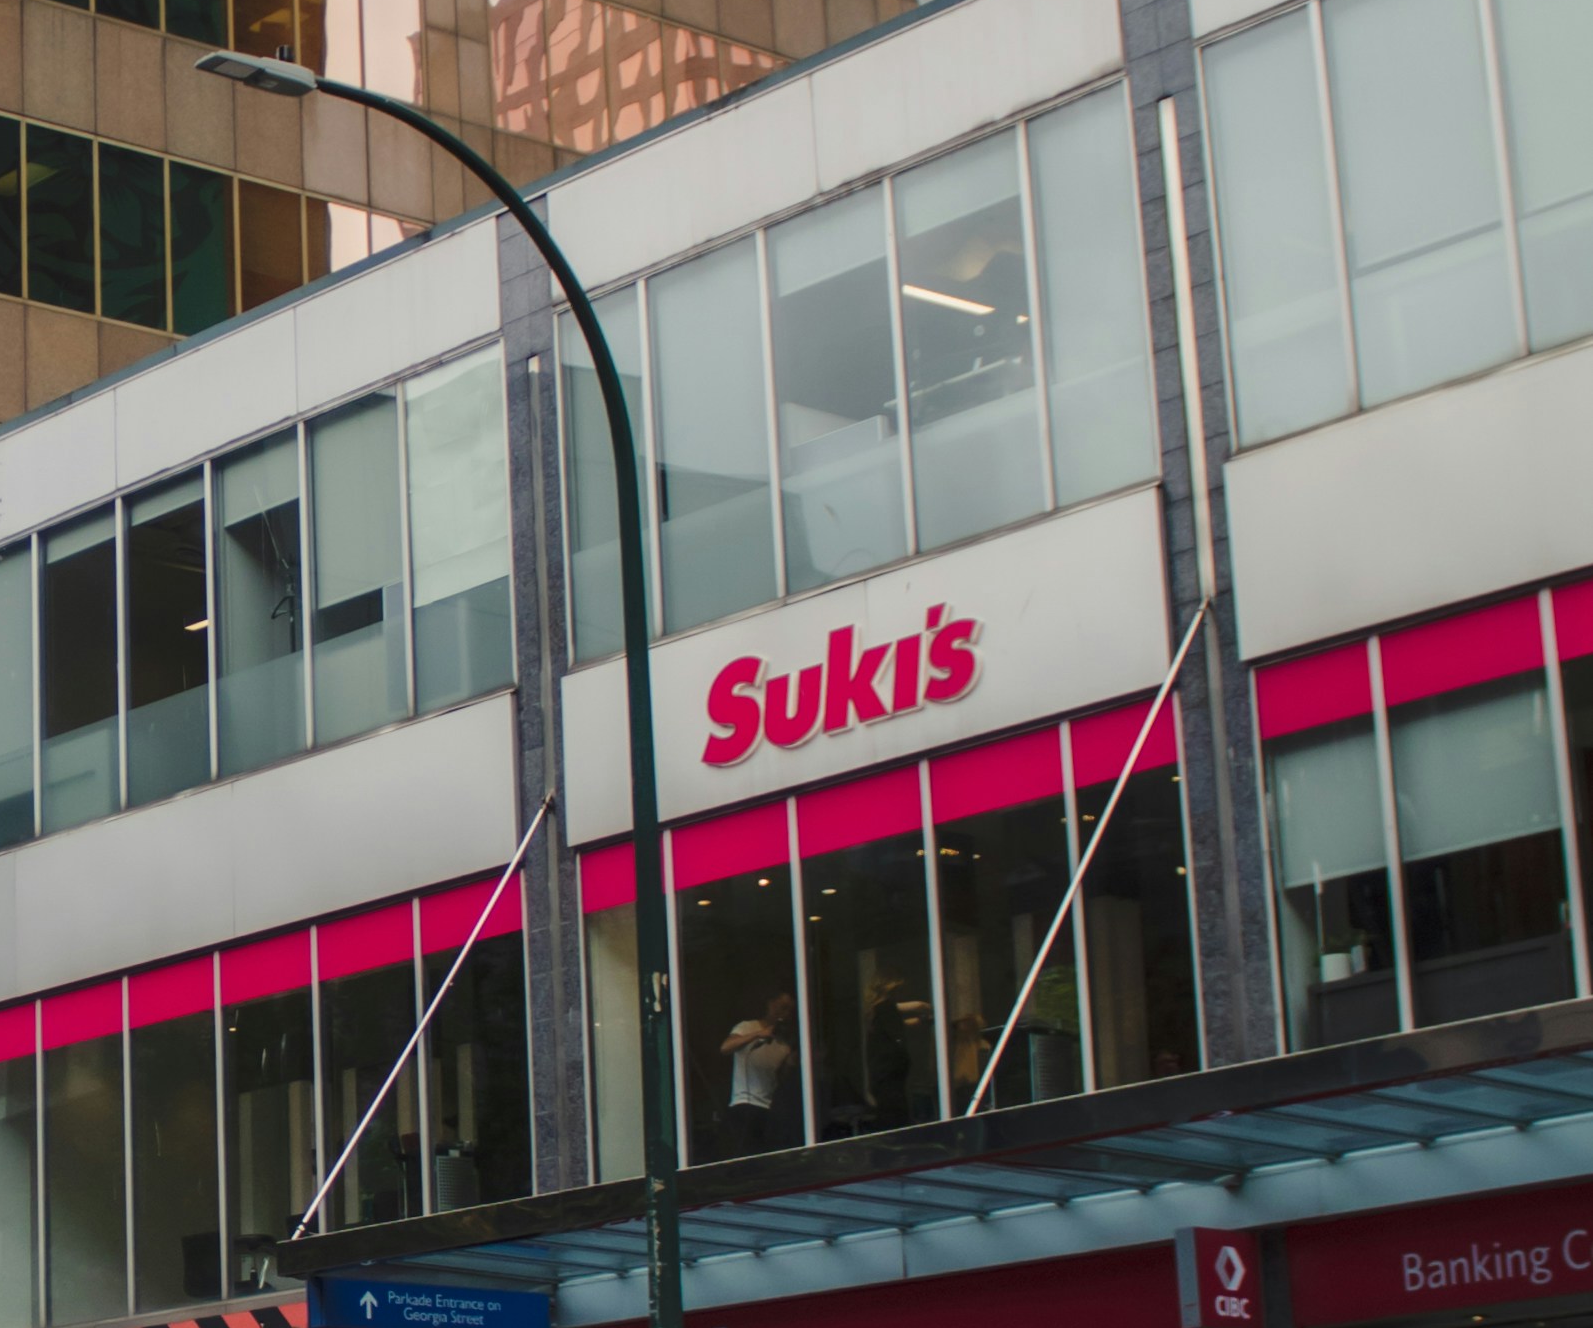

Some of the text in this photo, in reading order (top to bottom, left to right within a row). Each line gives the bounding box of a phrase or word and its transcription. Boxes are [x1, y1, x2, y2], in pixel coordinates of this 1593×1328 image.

[1403, 1229, 1593, 1291] Banking C
[388, 1290, 502, 1312] Parkade Entrance on
[1215, 1295, 1251, 1320] CIBC
[403, 1306, 485, 1327] Georgia Street
